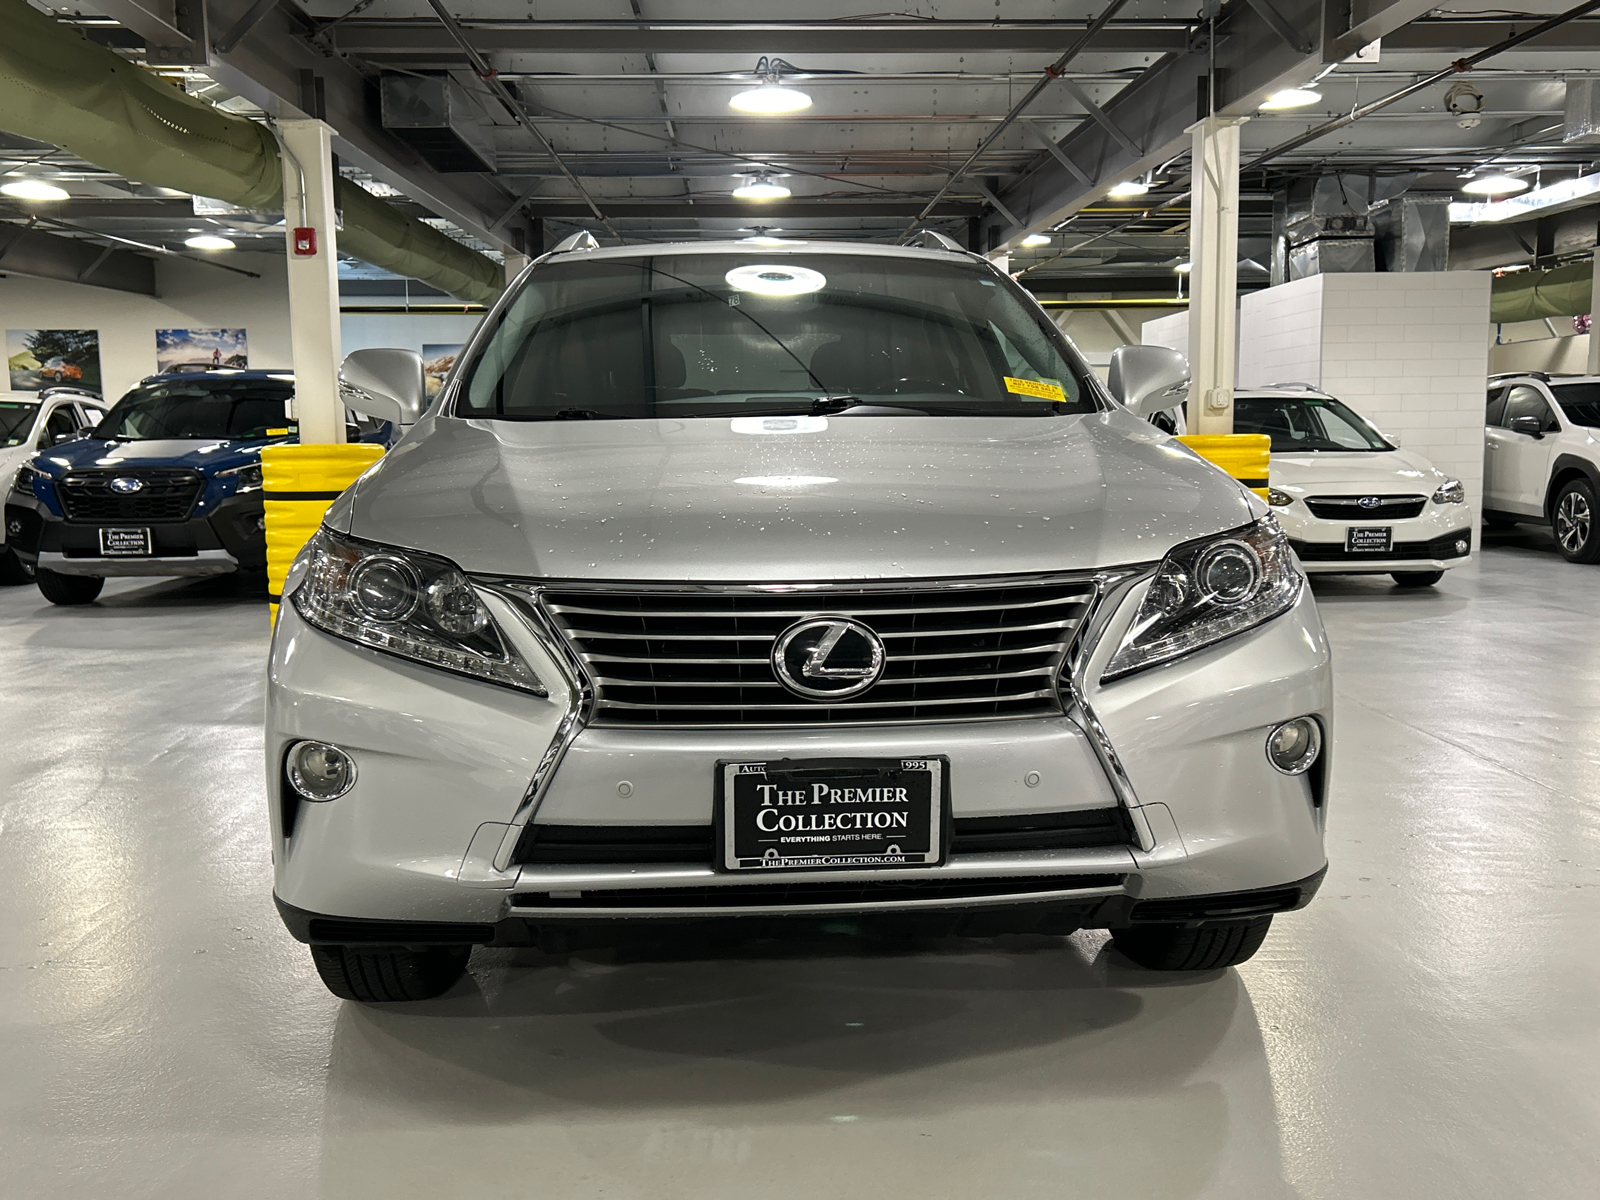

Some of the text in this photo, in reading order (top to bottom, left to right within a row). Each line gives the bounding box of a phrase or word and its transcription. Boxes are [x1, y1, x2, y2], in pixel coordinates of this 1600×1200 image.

[728, 295, 739, 306] 78
[1365, 530, 1387, 538] PREMIER
[756, 783, 909, 806] THE PREMIER
[756, 808, 909, 832] COLLECTION
[780, 833, 884, 843] EVERYTHING STARTS HERE.
